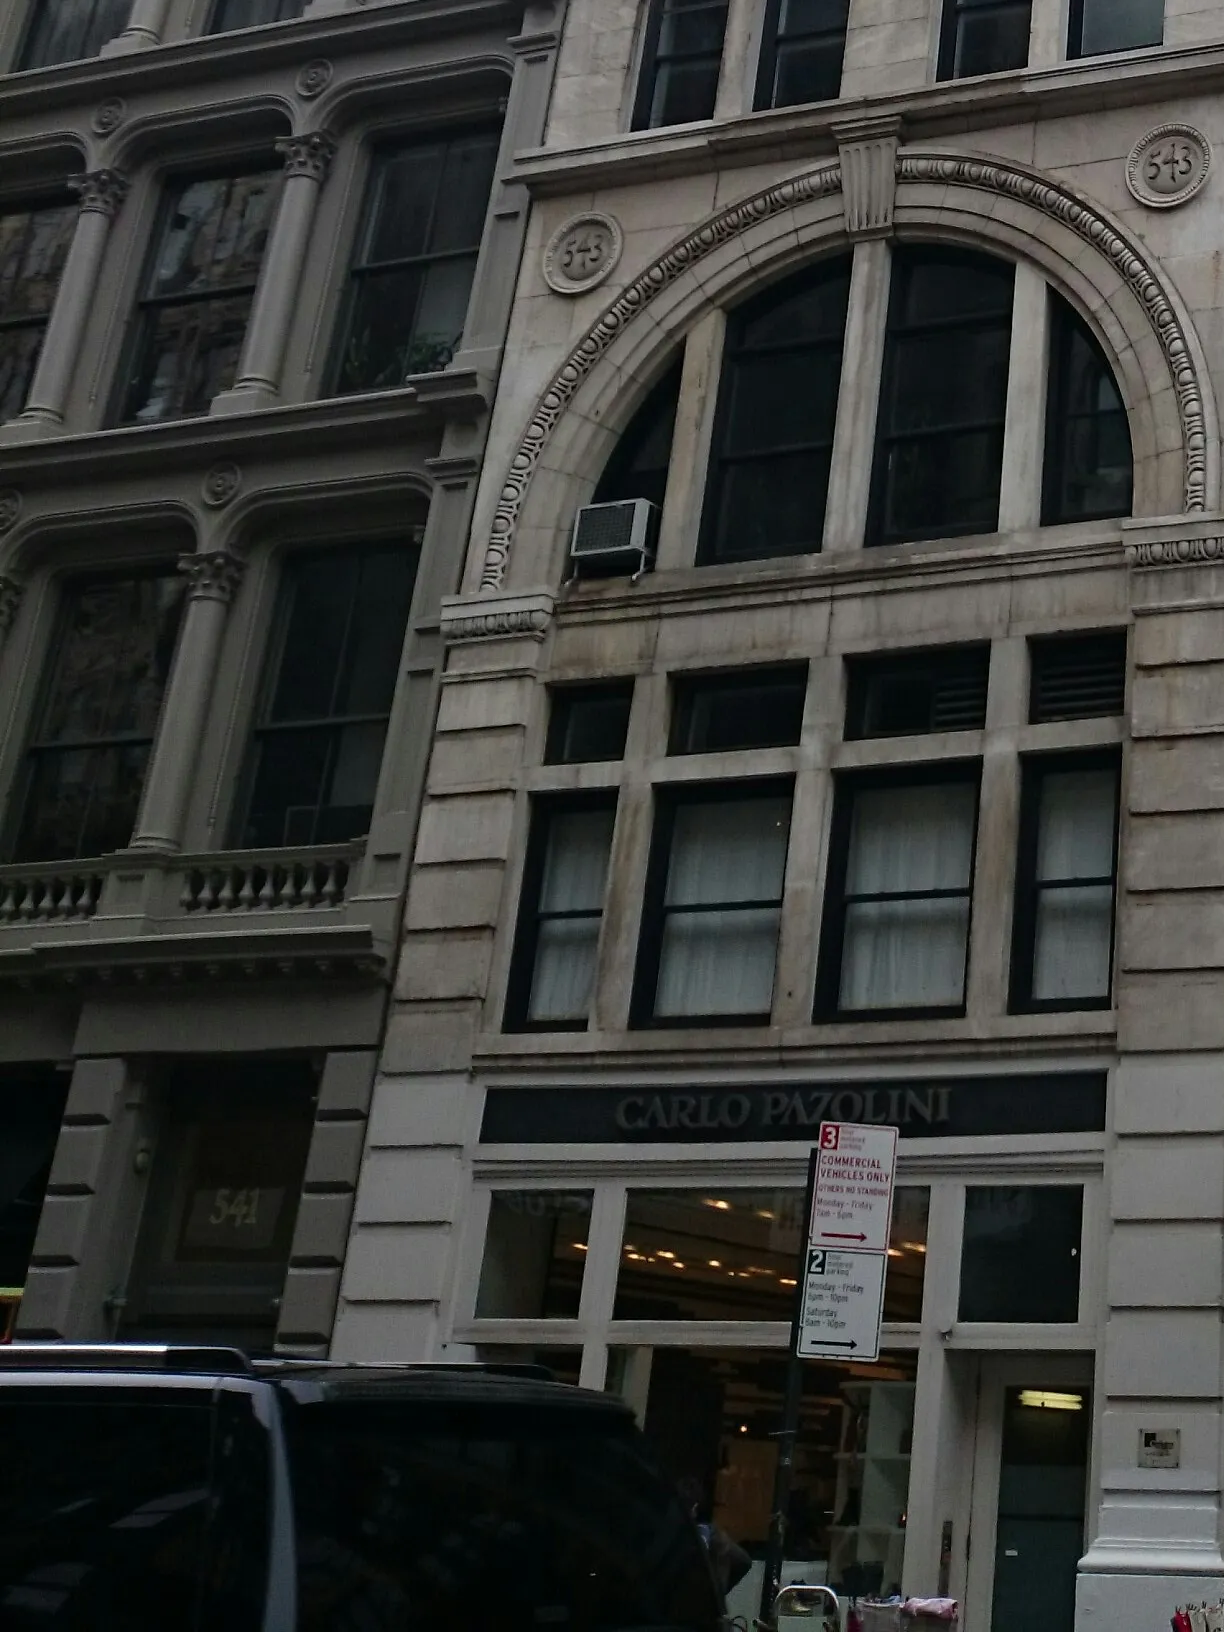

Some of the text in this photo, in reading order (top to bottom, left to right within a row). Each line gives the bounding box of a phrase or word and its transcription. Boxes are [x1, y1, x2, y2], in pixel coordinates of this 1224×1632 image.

[1148, 143, 1193, 183] 543
[563, 232, 603, 270] 543
[615, 1085, 953, 1130] CARLO PAZOLINI
[823, 1126, 837, 1150] 3
[821, 1155, 882, 1170] COMMERCIAL
[820, 1168, 890, 1183] VEHICLES ONLY
[818, 1183, 889, 1198] OTHERS NO STANDING
[209, 1187, 260, 1228] 541
[816, 1197, 844, 1209] Monday
[809, 1249, 824, 1273] 2
[809, 1281, 835, 1293] Monday
[842, 1283, 864, 1295] Friday
[806, 1307, 838, 1318] Saturday
